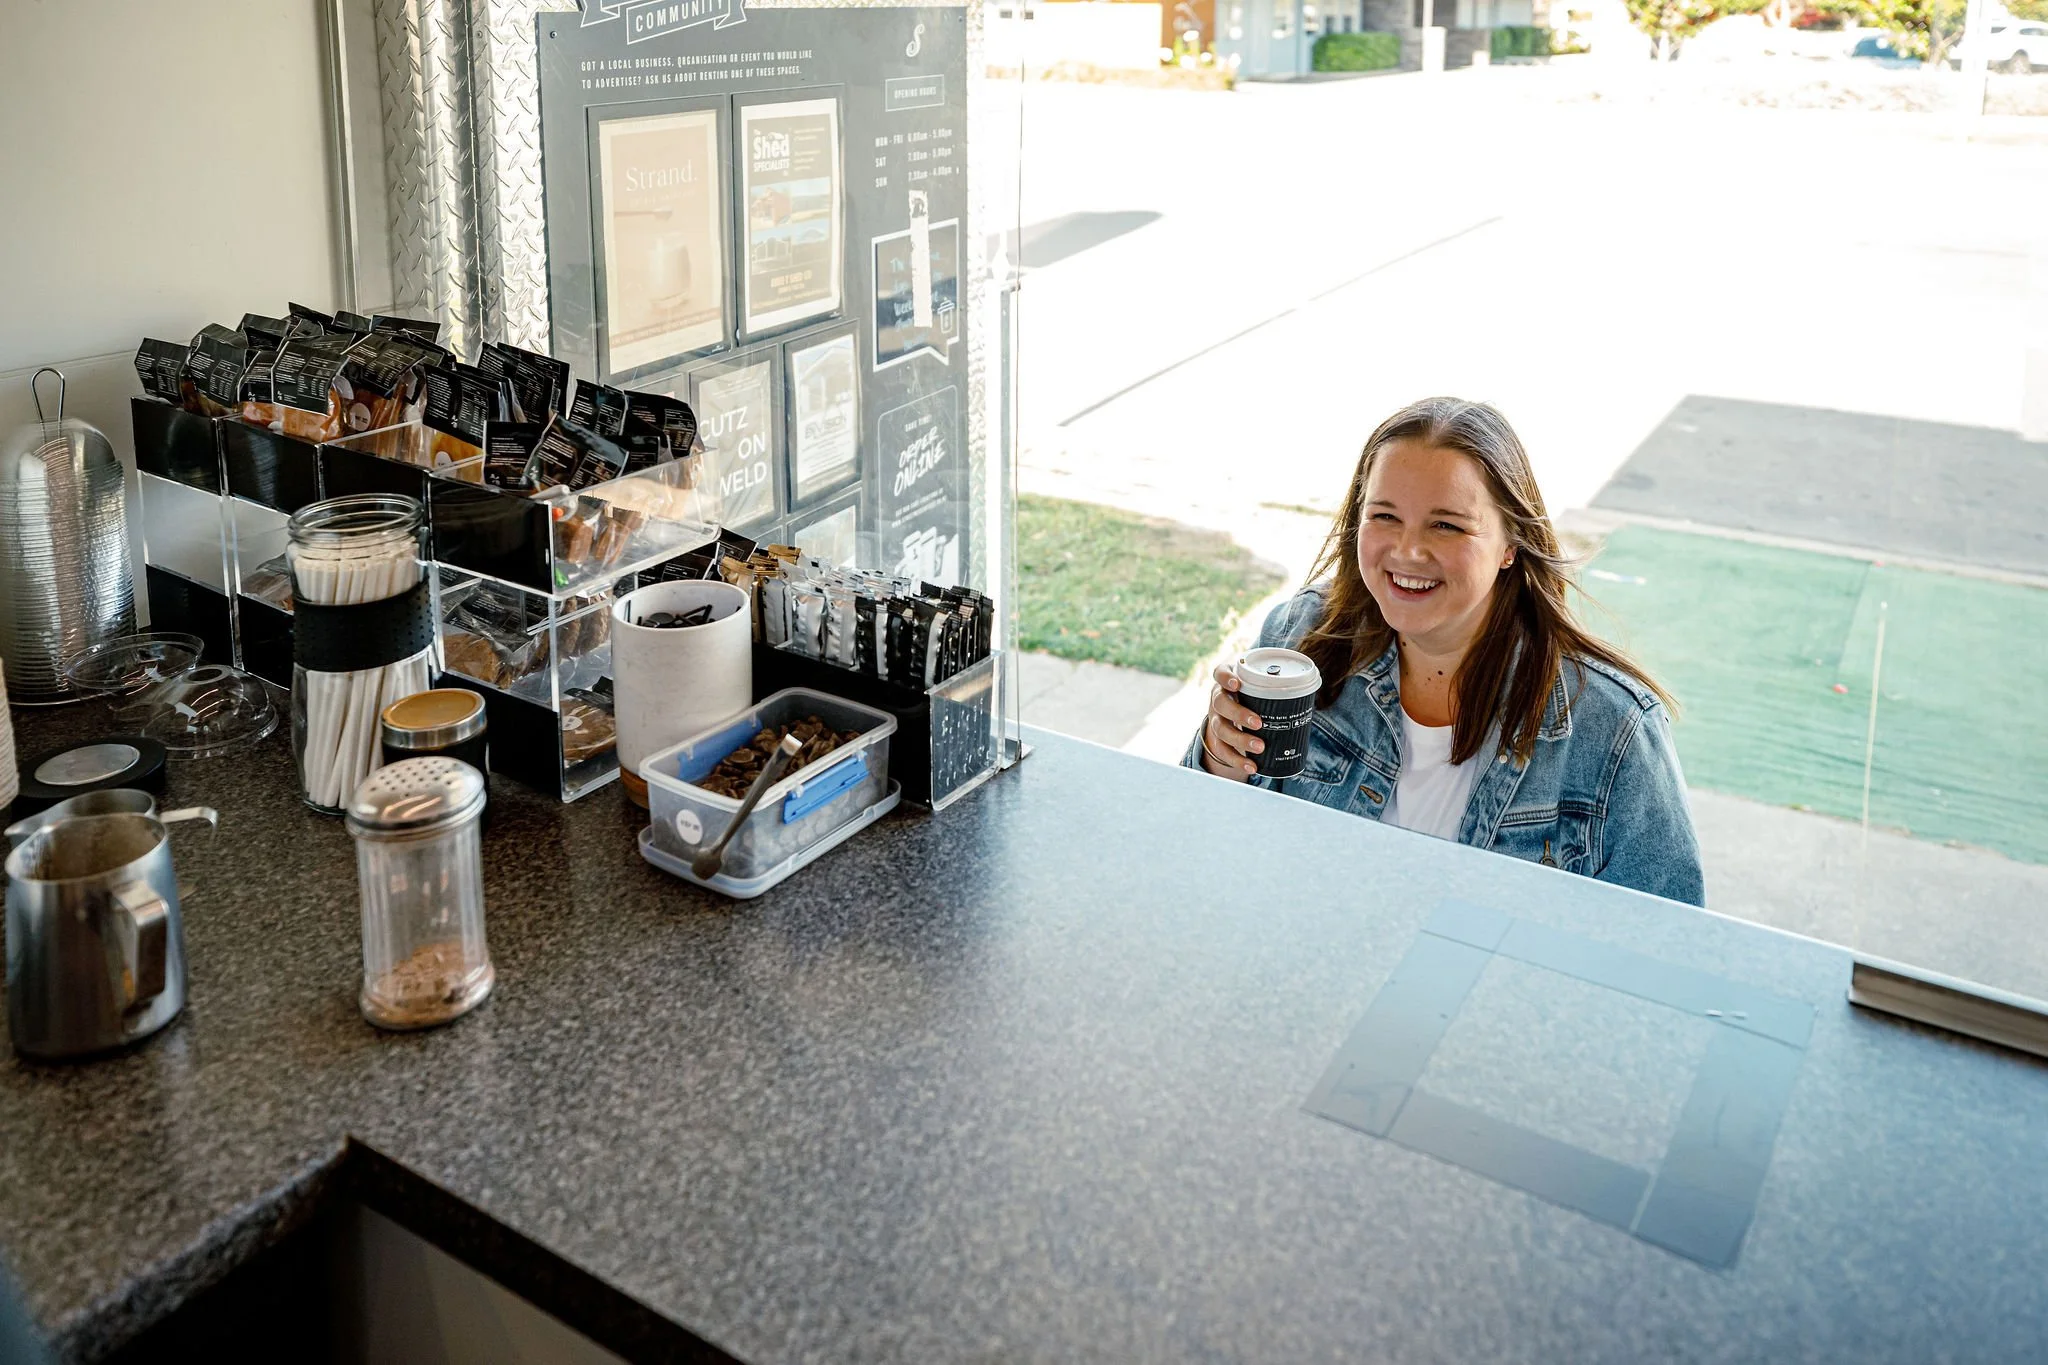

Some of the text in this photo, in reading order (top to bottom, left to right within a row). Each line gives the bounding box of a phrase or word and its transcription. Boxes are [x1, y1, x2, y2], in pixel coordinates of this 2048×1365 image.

[635, 0, 722, 33] COMMUNITY
[581, 61, 596, 71] GOT
[600, 60, 605, 70] A
[608, 59, 632, 70] LOCAL
[635, 57, 675, 68] BUSINESS,
[730, 53, 738, 63] OR
[741, 52, 761, 62] EVENT
[763, 51, 775, 61] YOU
[777, 50, 797, 60] WOULD
[799, 49, 813, 59] LIKE
[582, 65, 802, 89] TO ADVERTISE? ASK US ABOUT RENTING ONE OF THESE SPACES.
[894, 86, 937, 99] OPENING HOURS
[753, 133, 790, 160] Shed
[875, 136, 888, 148] MON
[893, 134, 904, 145] FRI
[625, 159, 698, 192] Strand.
[875, 156, 887, 168] SAT
[875, 176, 888, 188] SUN
[699, 406, 749, 442] CUTZ
[738, 431, 766, 459] ON
[898, 425, 940, 469] ORDER
[893, 438, 946, 497] ONLINE
